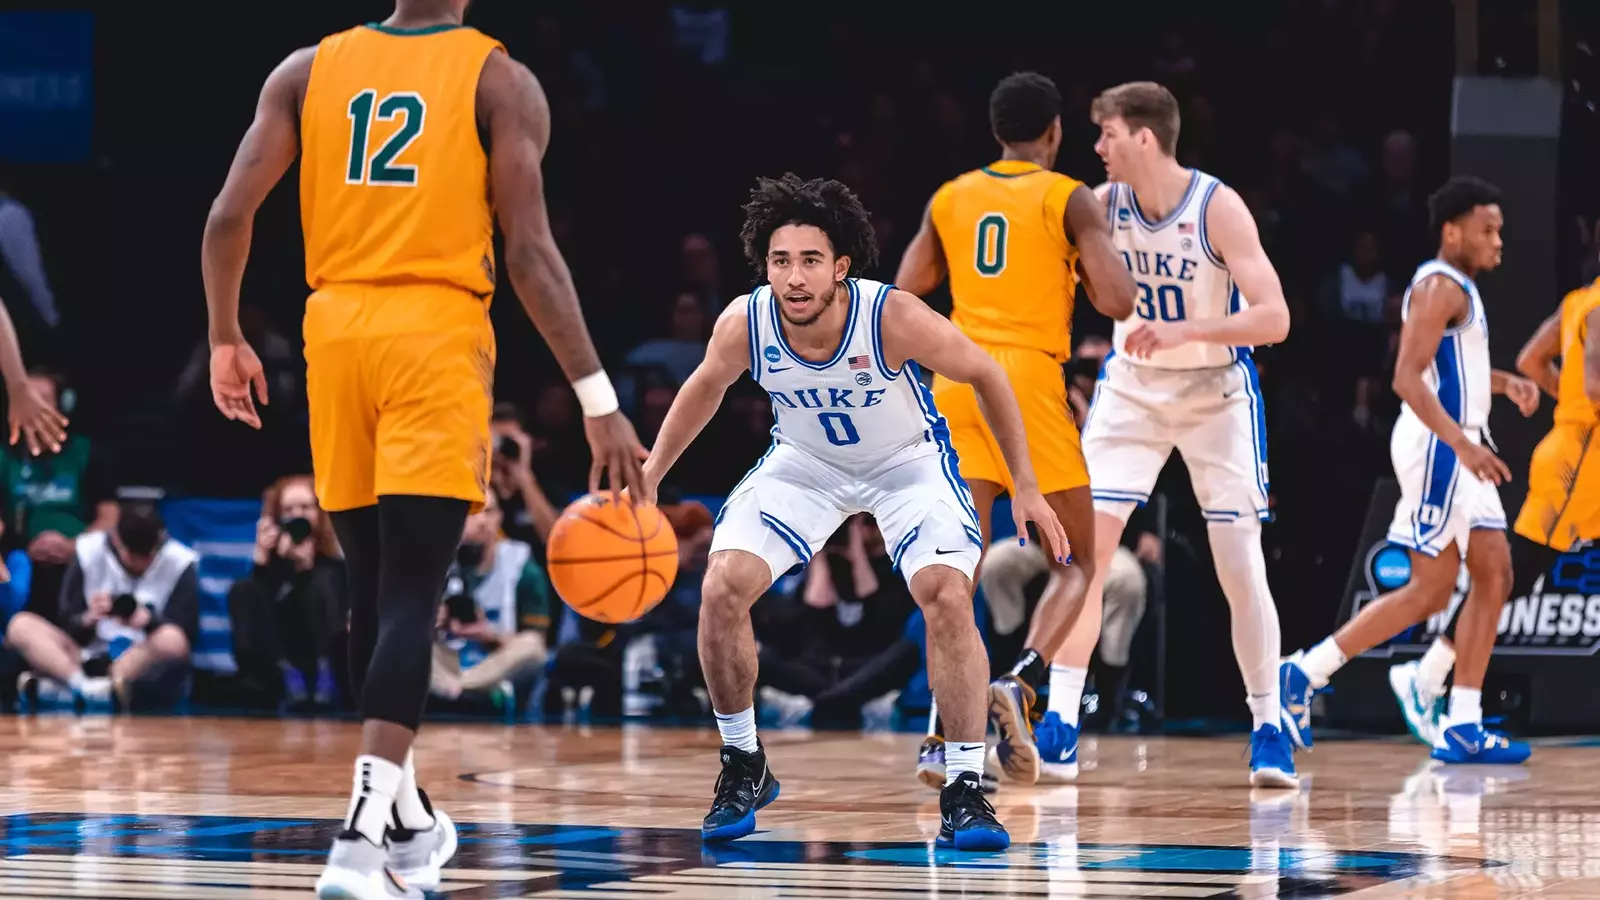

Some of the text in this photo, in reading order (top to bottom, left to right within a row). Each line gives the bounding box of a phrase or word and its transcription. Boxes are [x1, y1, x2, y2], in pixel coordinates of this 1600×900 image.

[345, 88, 427, 187] 12
[974, 212, 1009, 278] 0
[1136, 281, 1187, 323] 30
[767, 387, 887, 409] DUKE
[817, 412, 861, 446] 0
